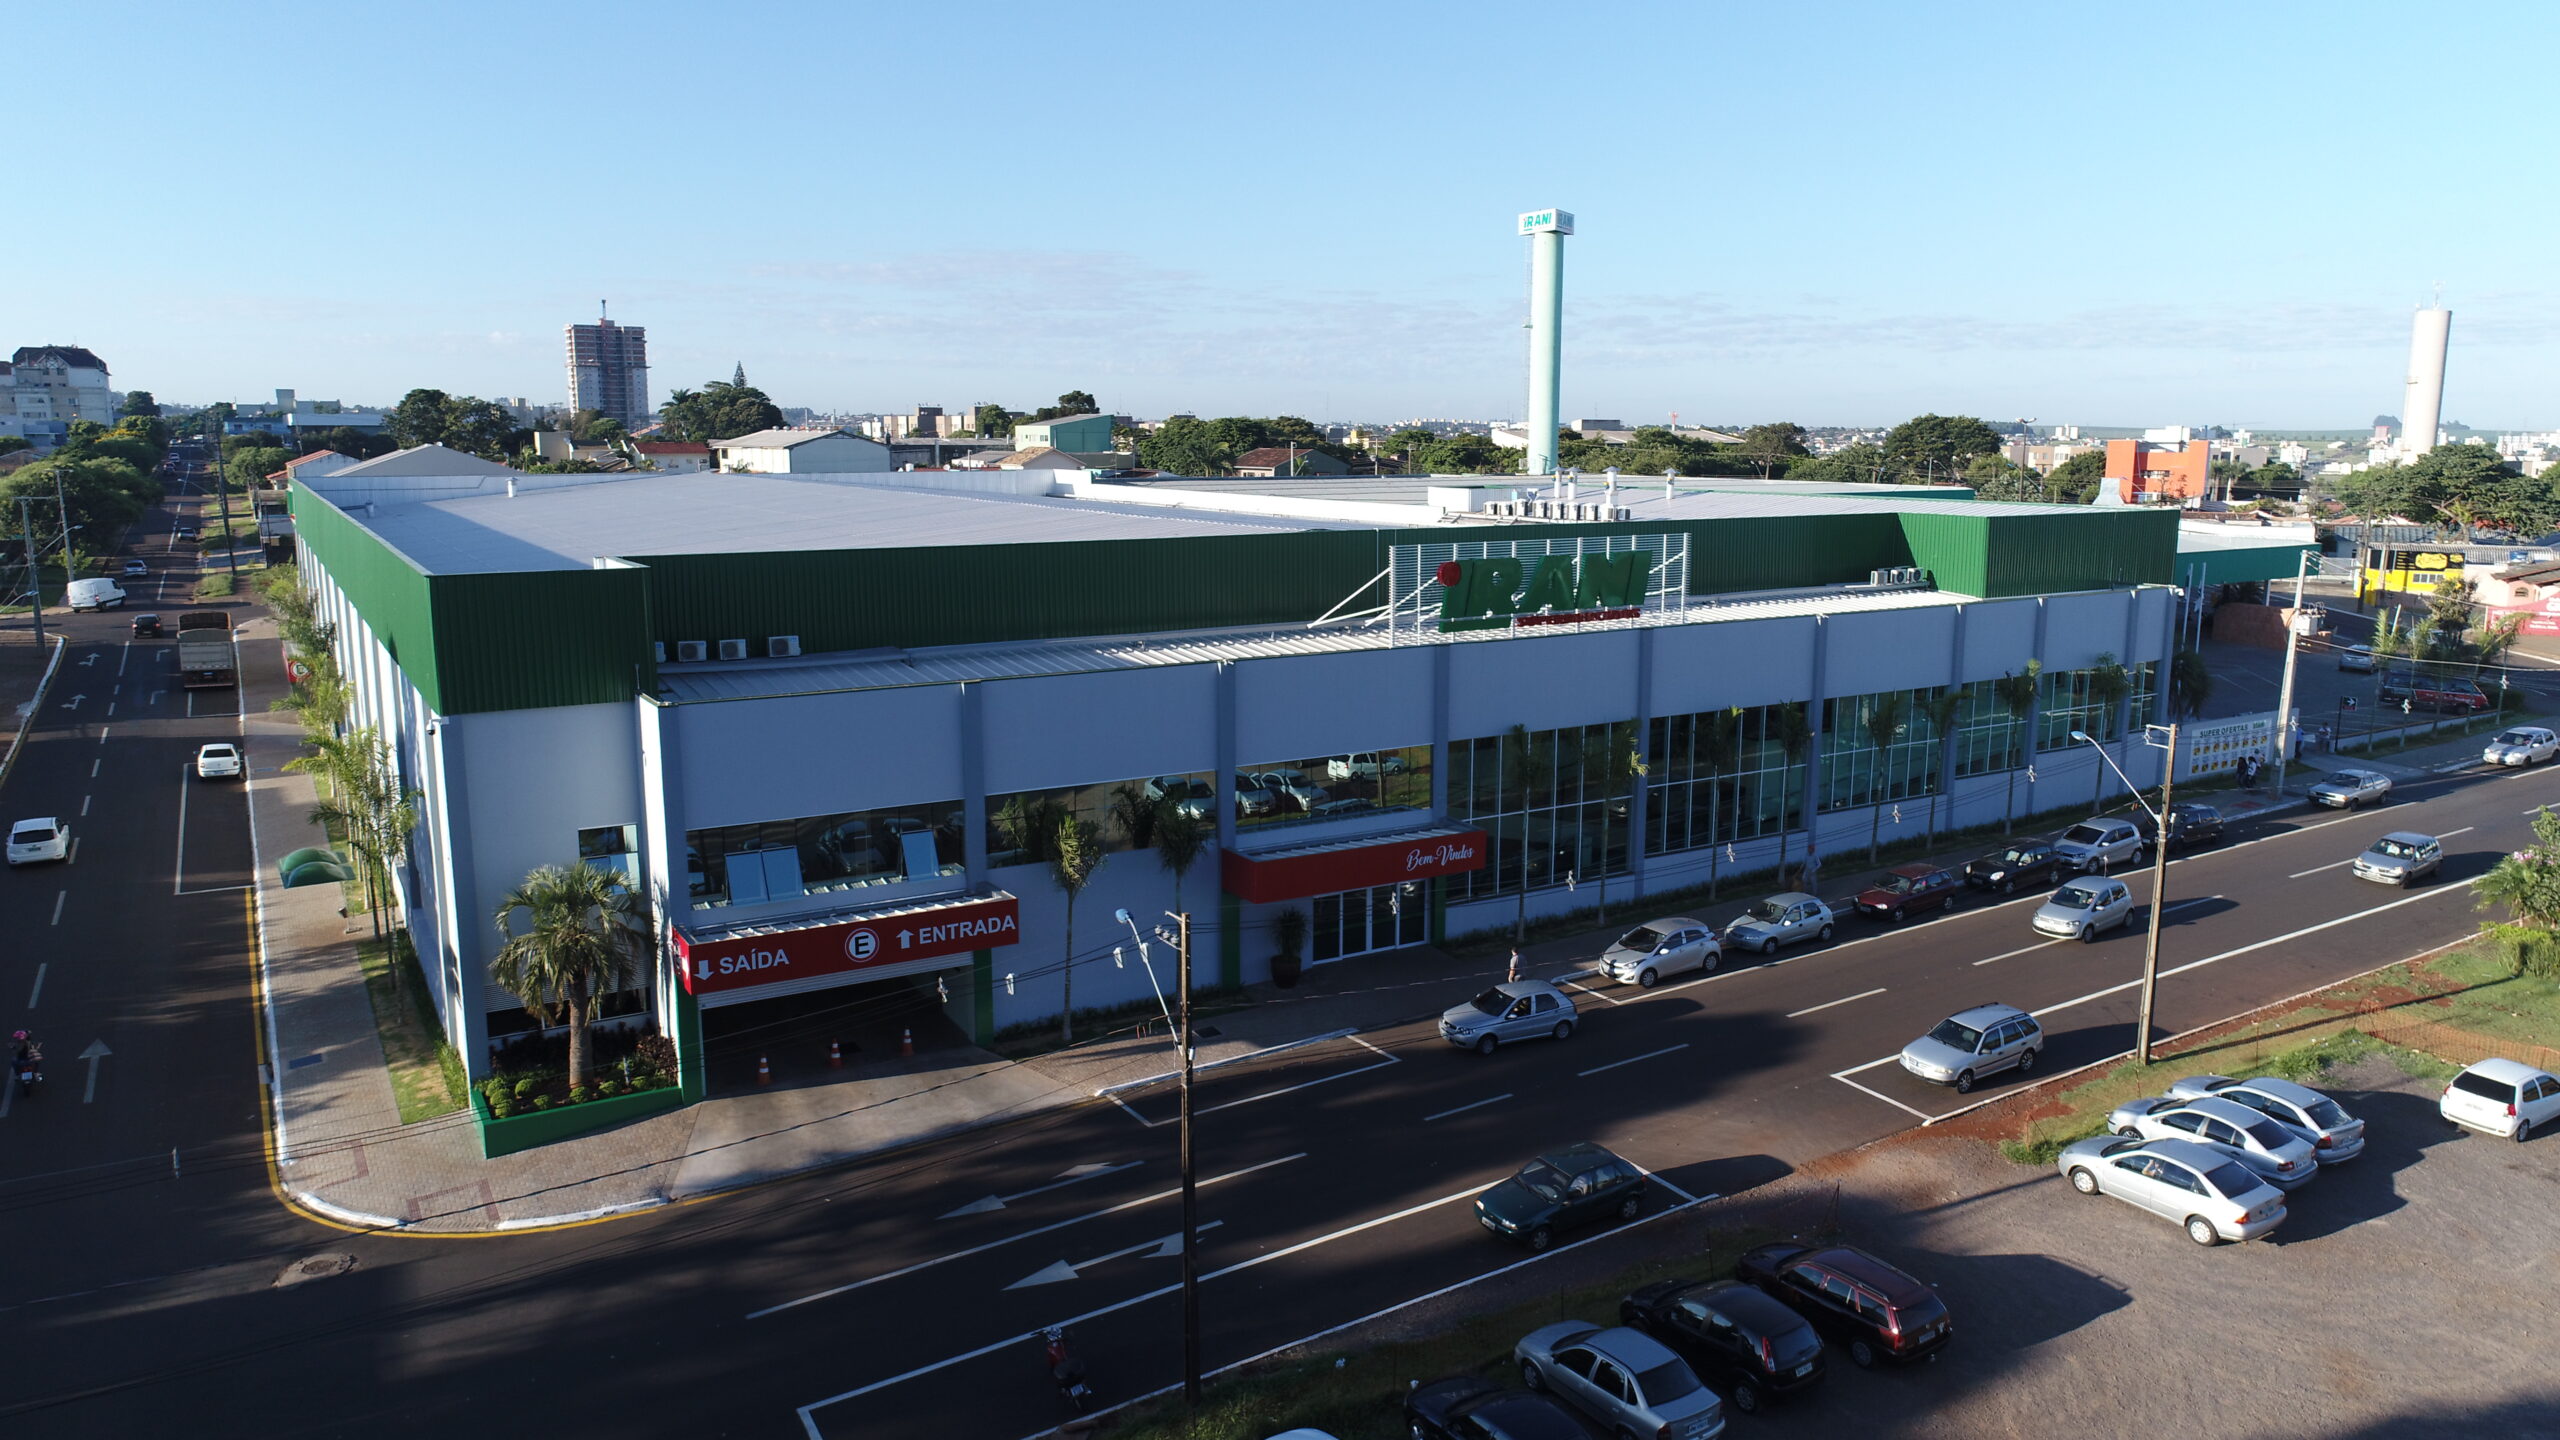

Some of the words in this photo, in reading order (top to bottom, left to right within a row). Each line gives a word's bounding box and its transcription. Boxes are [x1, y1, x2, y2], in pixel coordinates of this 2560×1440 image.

[2200, 728, 2220, 738] SUPER
[719, 947, 789, 975] SAÍDA
[854, 935, 871, 955] E
[919, 914, 1016, 944] ENTRADA
